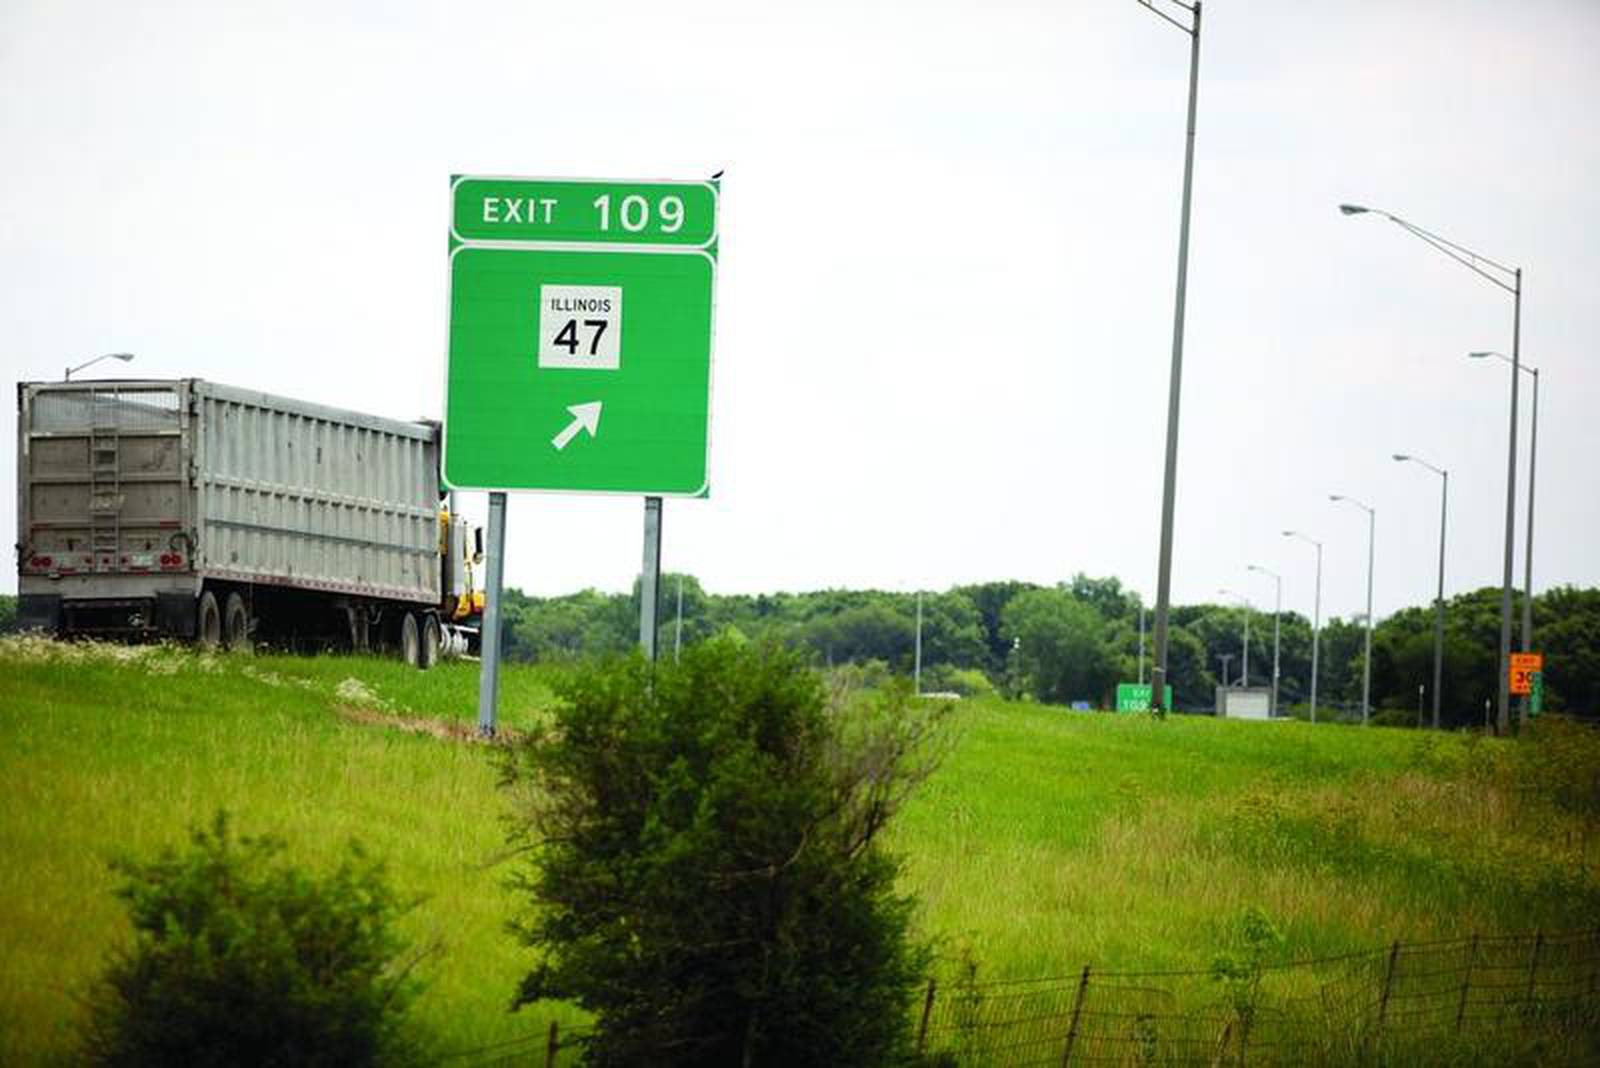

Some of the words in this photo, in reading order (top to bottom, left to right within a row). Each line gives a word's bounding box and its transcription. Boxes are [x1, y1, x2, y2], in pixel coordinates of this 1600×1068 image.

[483, 198, 557, 224] EXIT
[593, 195, 685, 233] 109
[551, 299, 611, 313] ILLINOIS
[553, 319, 608, 355] 47
